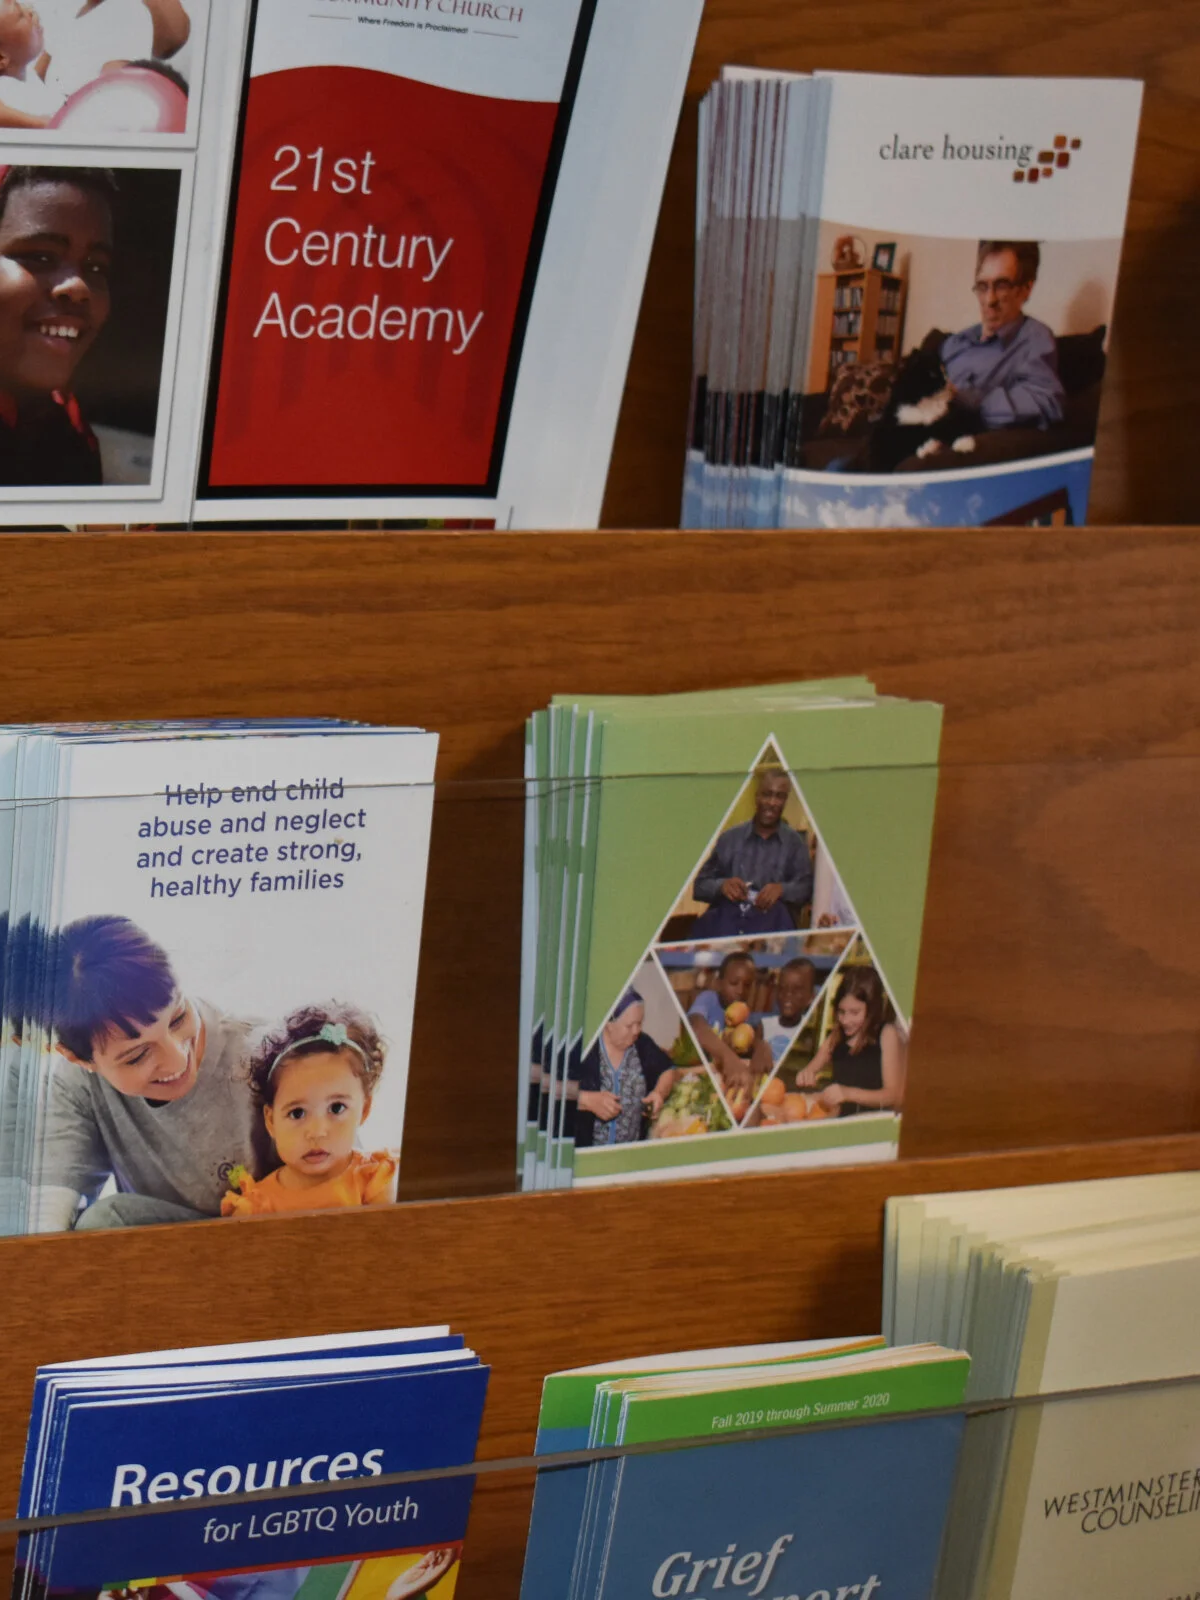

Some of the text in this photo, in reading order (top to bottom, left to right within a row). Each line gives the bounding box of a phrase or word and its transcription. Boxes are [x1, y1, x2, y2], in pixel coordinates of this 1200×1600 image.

[357, 15, 381, 26] Where
[383, 18, 415, 29] Freedom
[438, 0, 524, 22] CHURCH
[879, 133, 1033, 168] clare housing
[270, 144, 376, 195] 21st
[264, 217, 454, 282] Century
[253, 292, 484, 355] Academy
[165, 777, 345, 808] Help end child
[138, 808, 366, 838] abuse and neglect
[137, 841, 362, 868] and create strong,
[150, 869, 345, 898] healthy families
[711, 1392, 891, 1430] Fall 2019 through Summer 2020
[110, 1447, 385, 1508] Resources
[203, 1496, 419, 1544] for LGBTQ Youth
[651, 1533, 795, 1599] Grief
